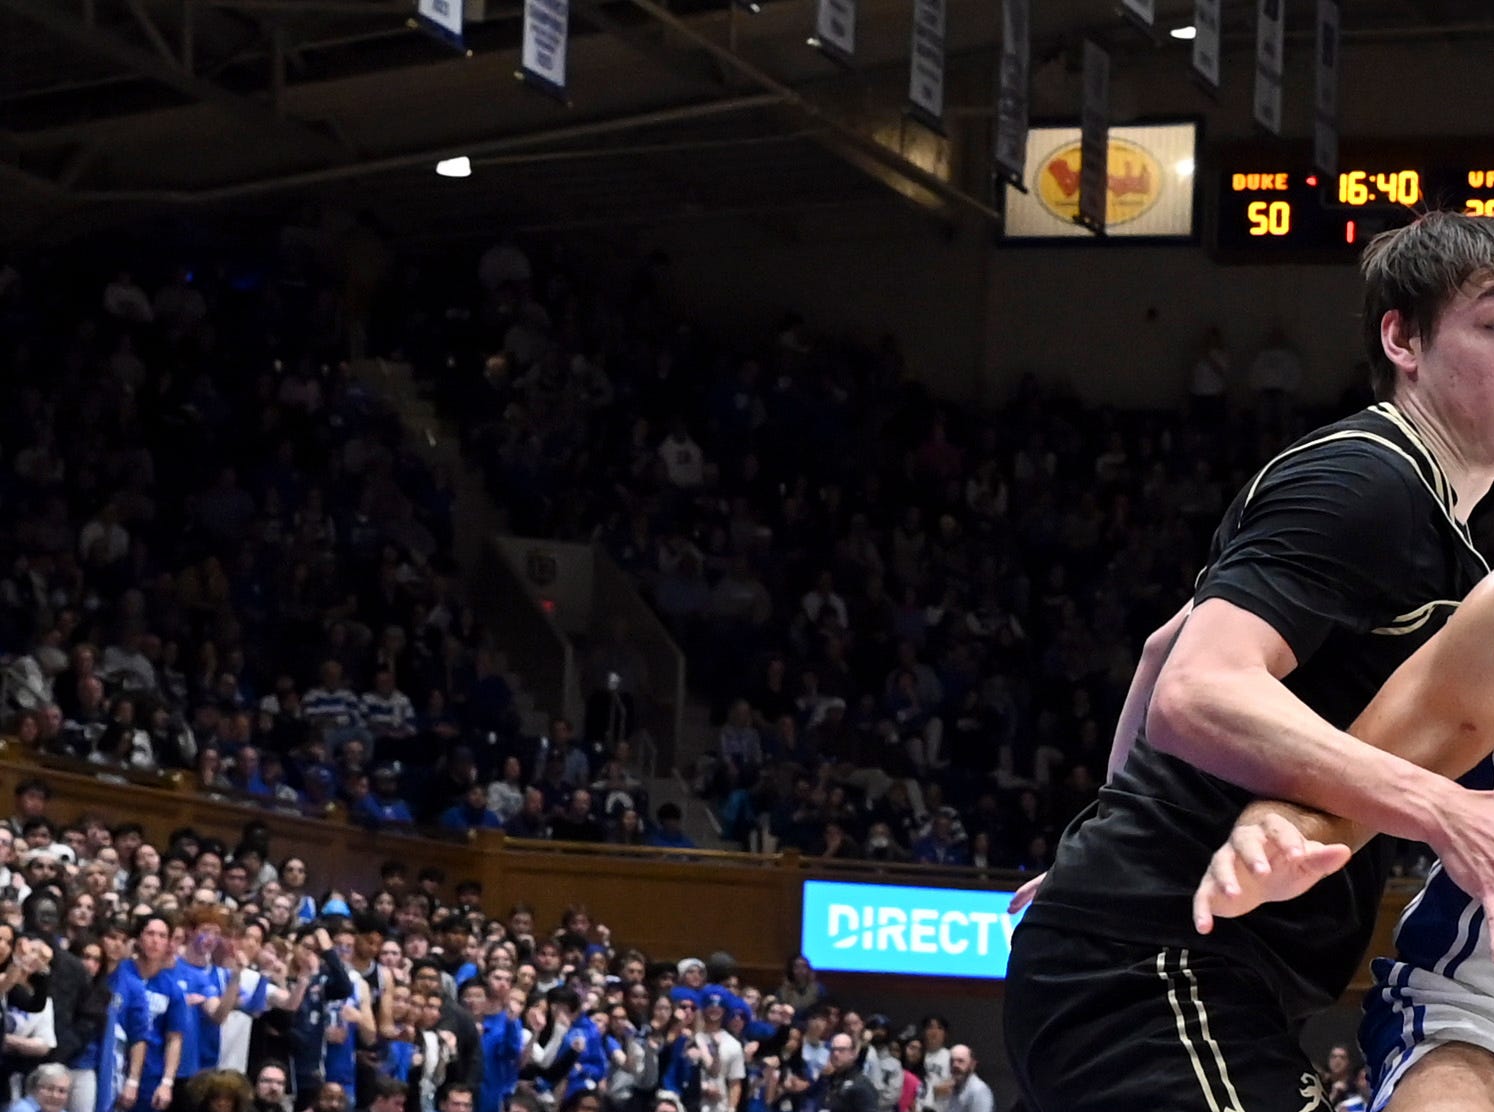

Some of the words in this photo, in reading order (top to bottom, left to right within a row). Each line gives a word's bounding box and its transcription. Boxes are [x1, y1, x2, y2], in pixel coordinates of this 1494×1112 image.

[1232, 173, 1289, 191] DUKE
[1339, 170, 1419, 205] 16:40
[1247, 201, 1290, 236] 50
